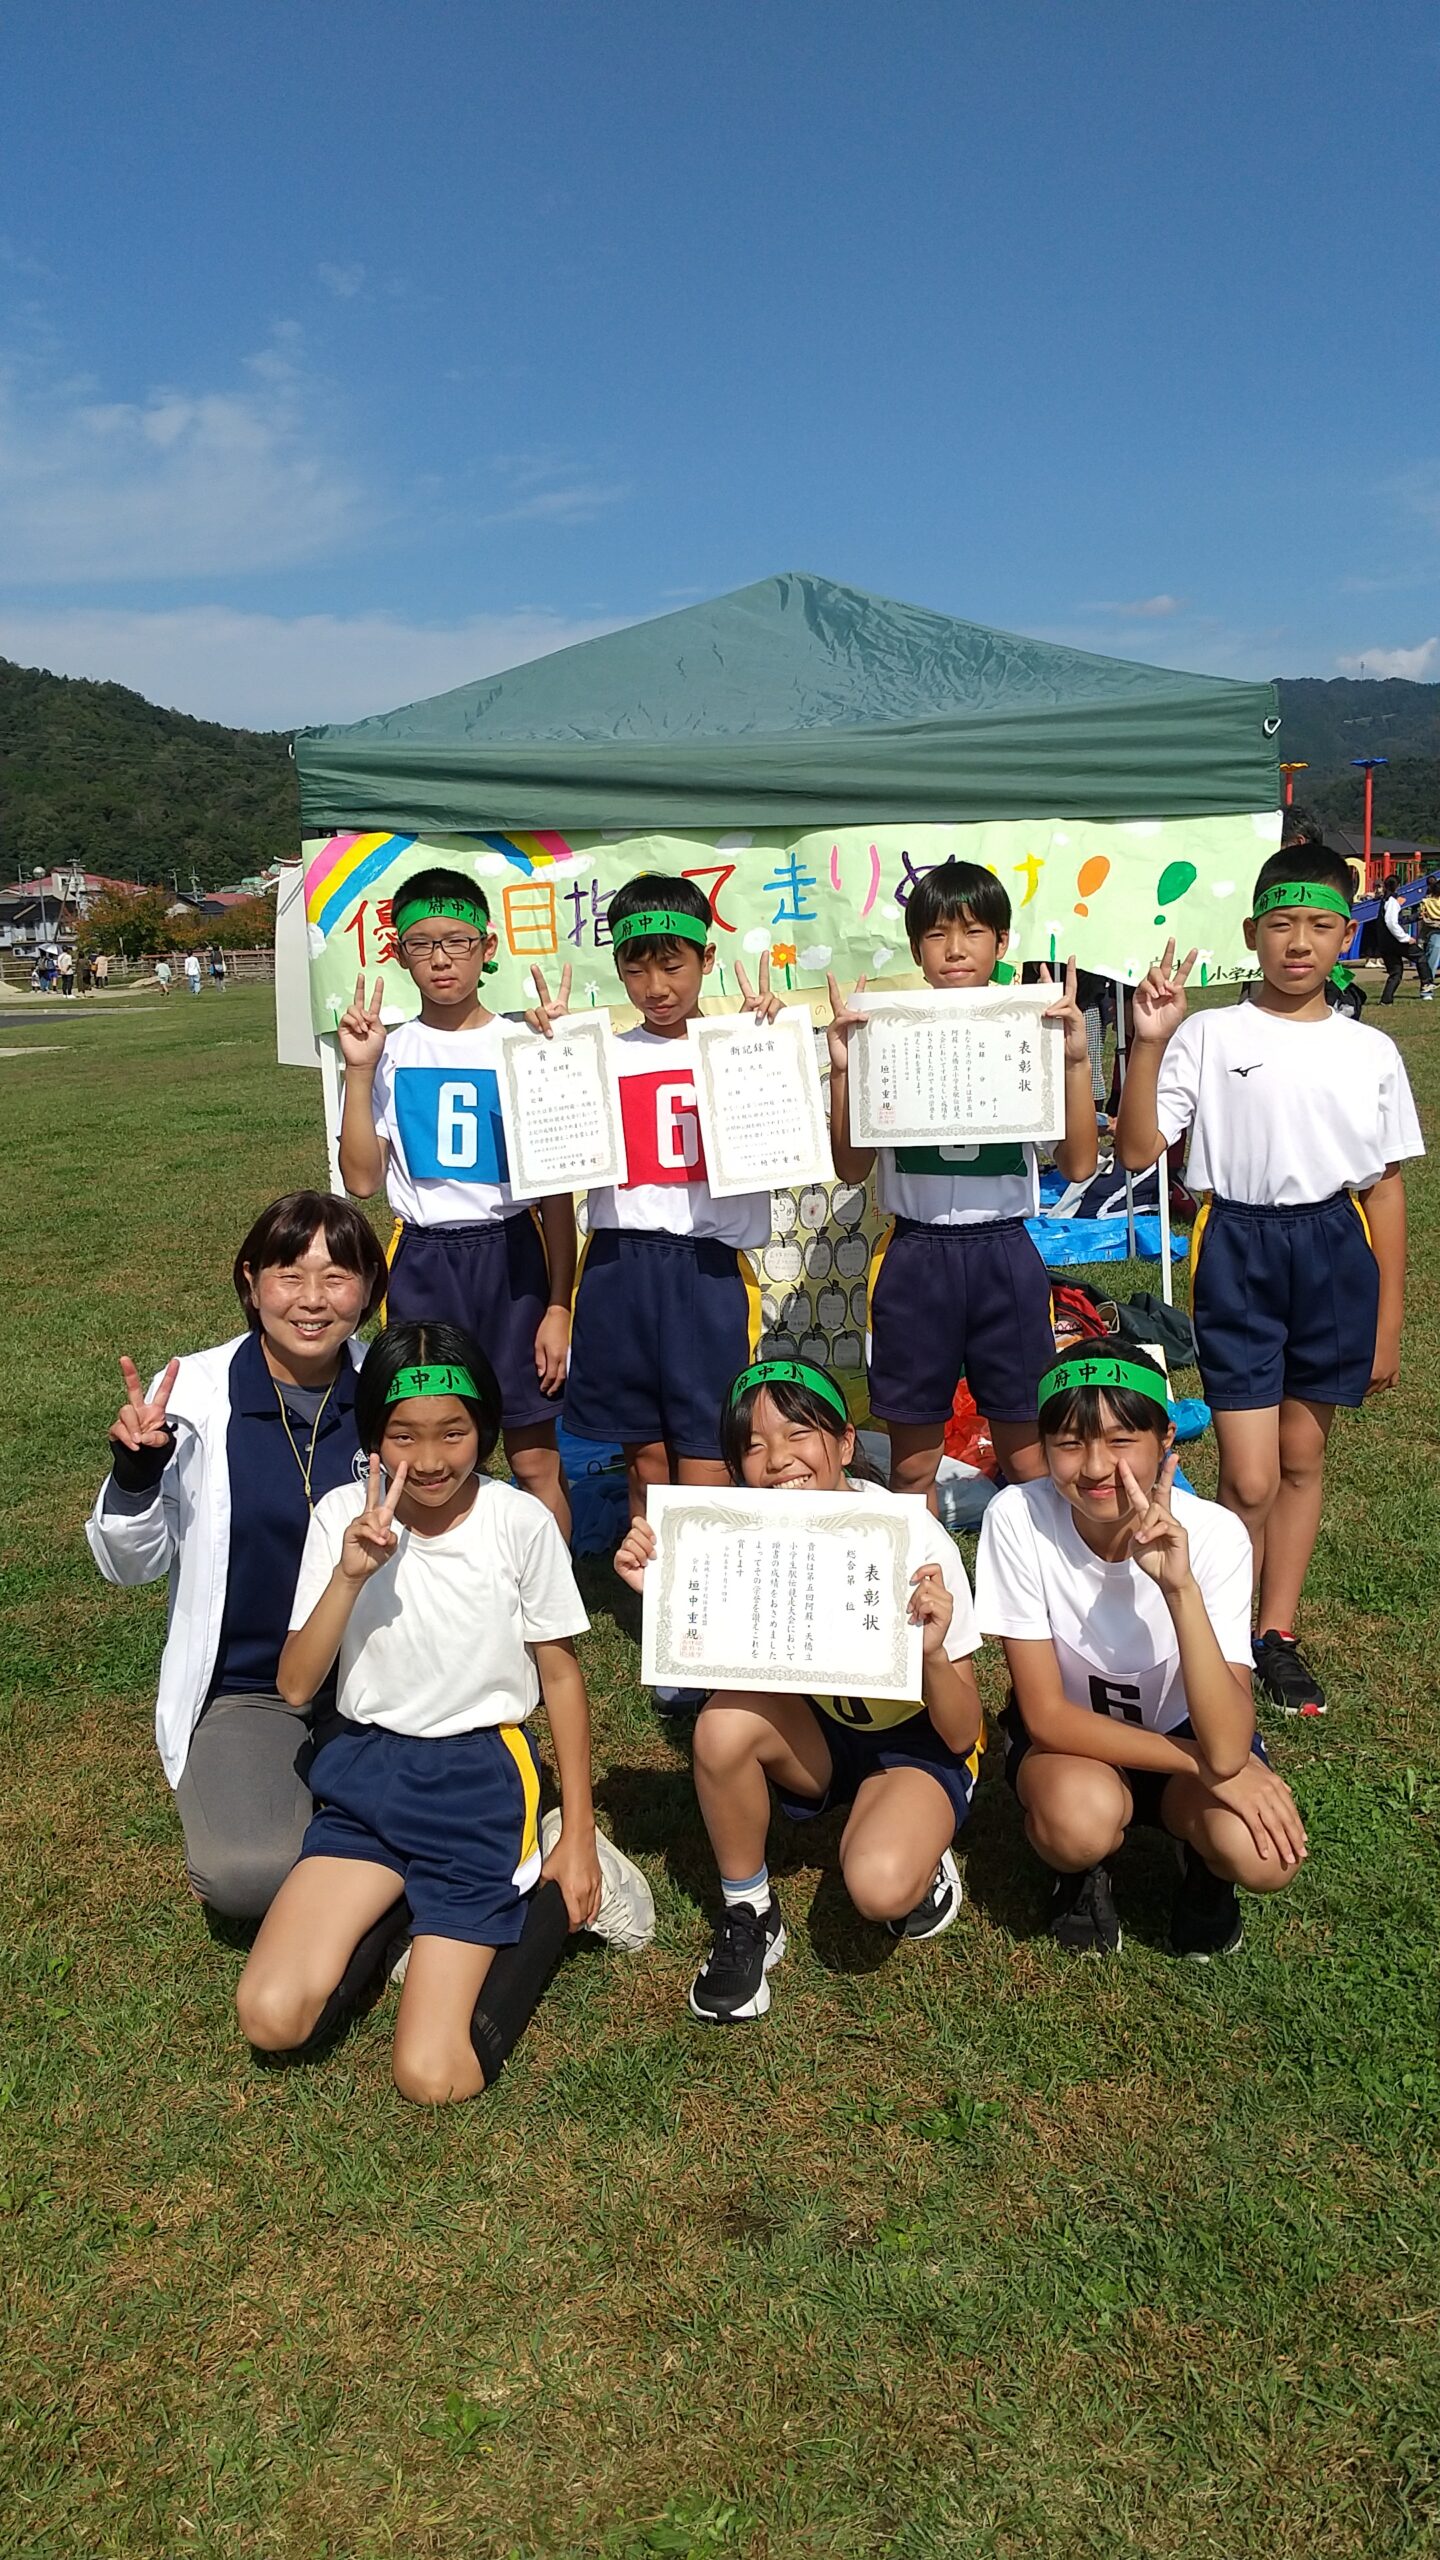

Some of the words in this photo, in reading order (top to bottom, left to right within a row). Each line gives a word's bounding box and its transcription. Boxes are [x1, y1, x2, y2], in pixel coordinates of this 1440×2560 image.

[428, 898, 480, 923] 府中小
[1259, 886, 1312, 910] 府中小
[621, 914, 677, 937] 府中小
[730, 1040, 775, 1056] 新記録賞
[1018, 1040, 1033, 1093] 表彰状
[437, 1082, 477, 1168] 6
[656, 1083, 699, 1168] 6
[737, 1364, 804, 1393] 府中小
[1053, 1362, 1129, 1391] 府中小
[735, 1538, 746, 1578] 賞します
[785, 1540, 798, 1662] 小学生駅伝競走大会において
[862, 1563, 881, 1631] 表彰状
